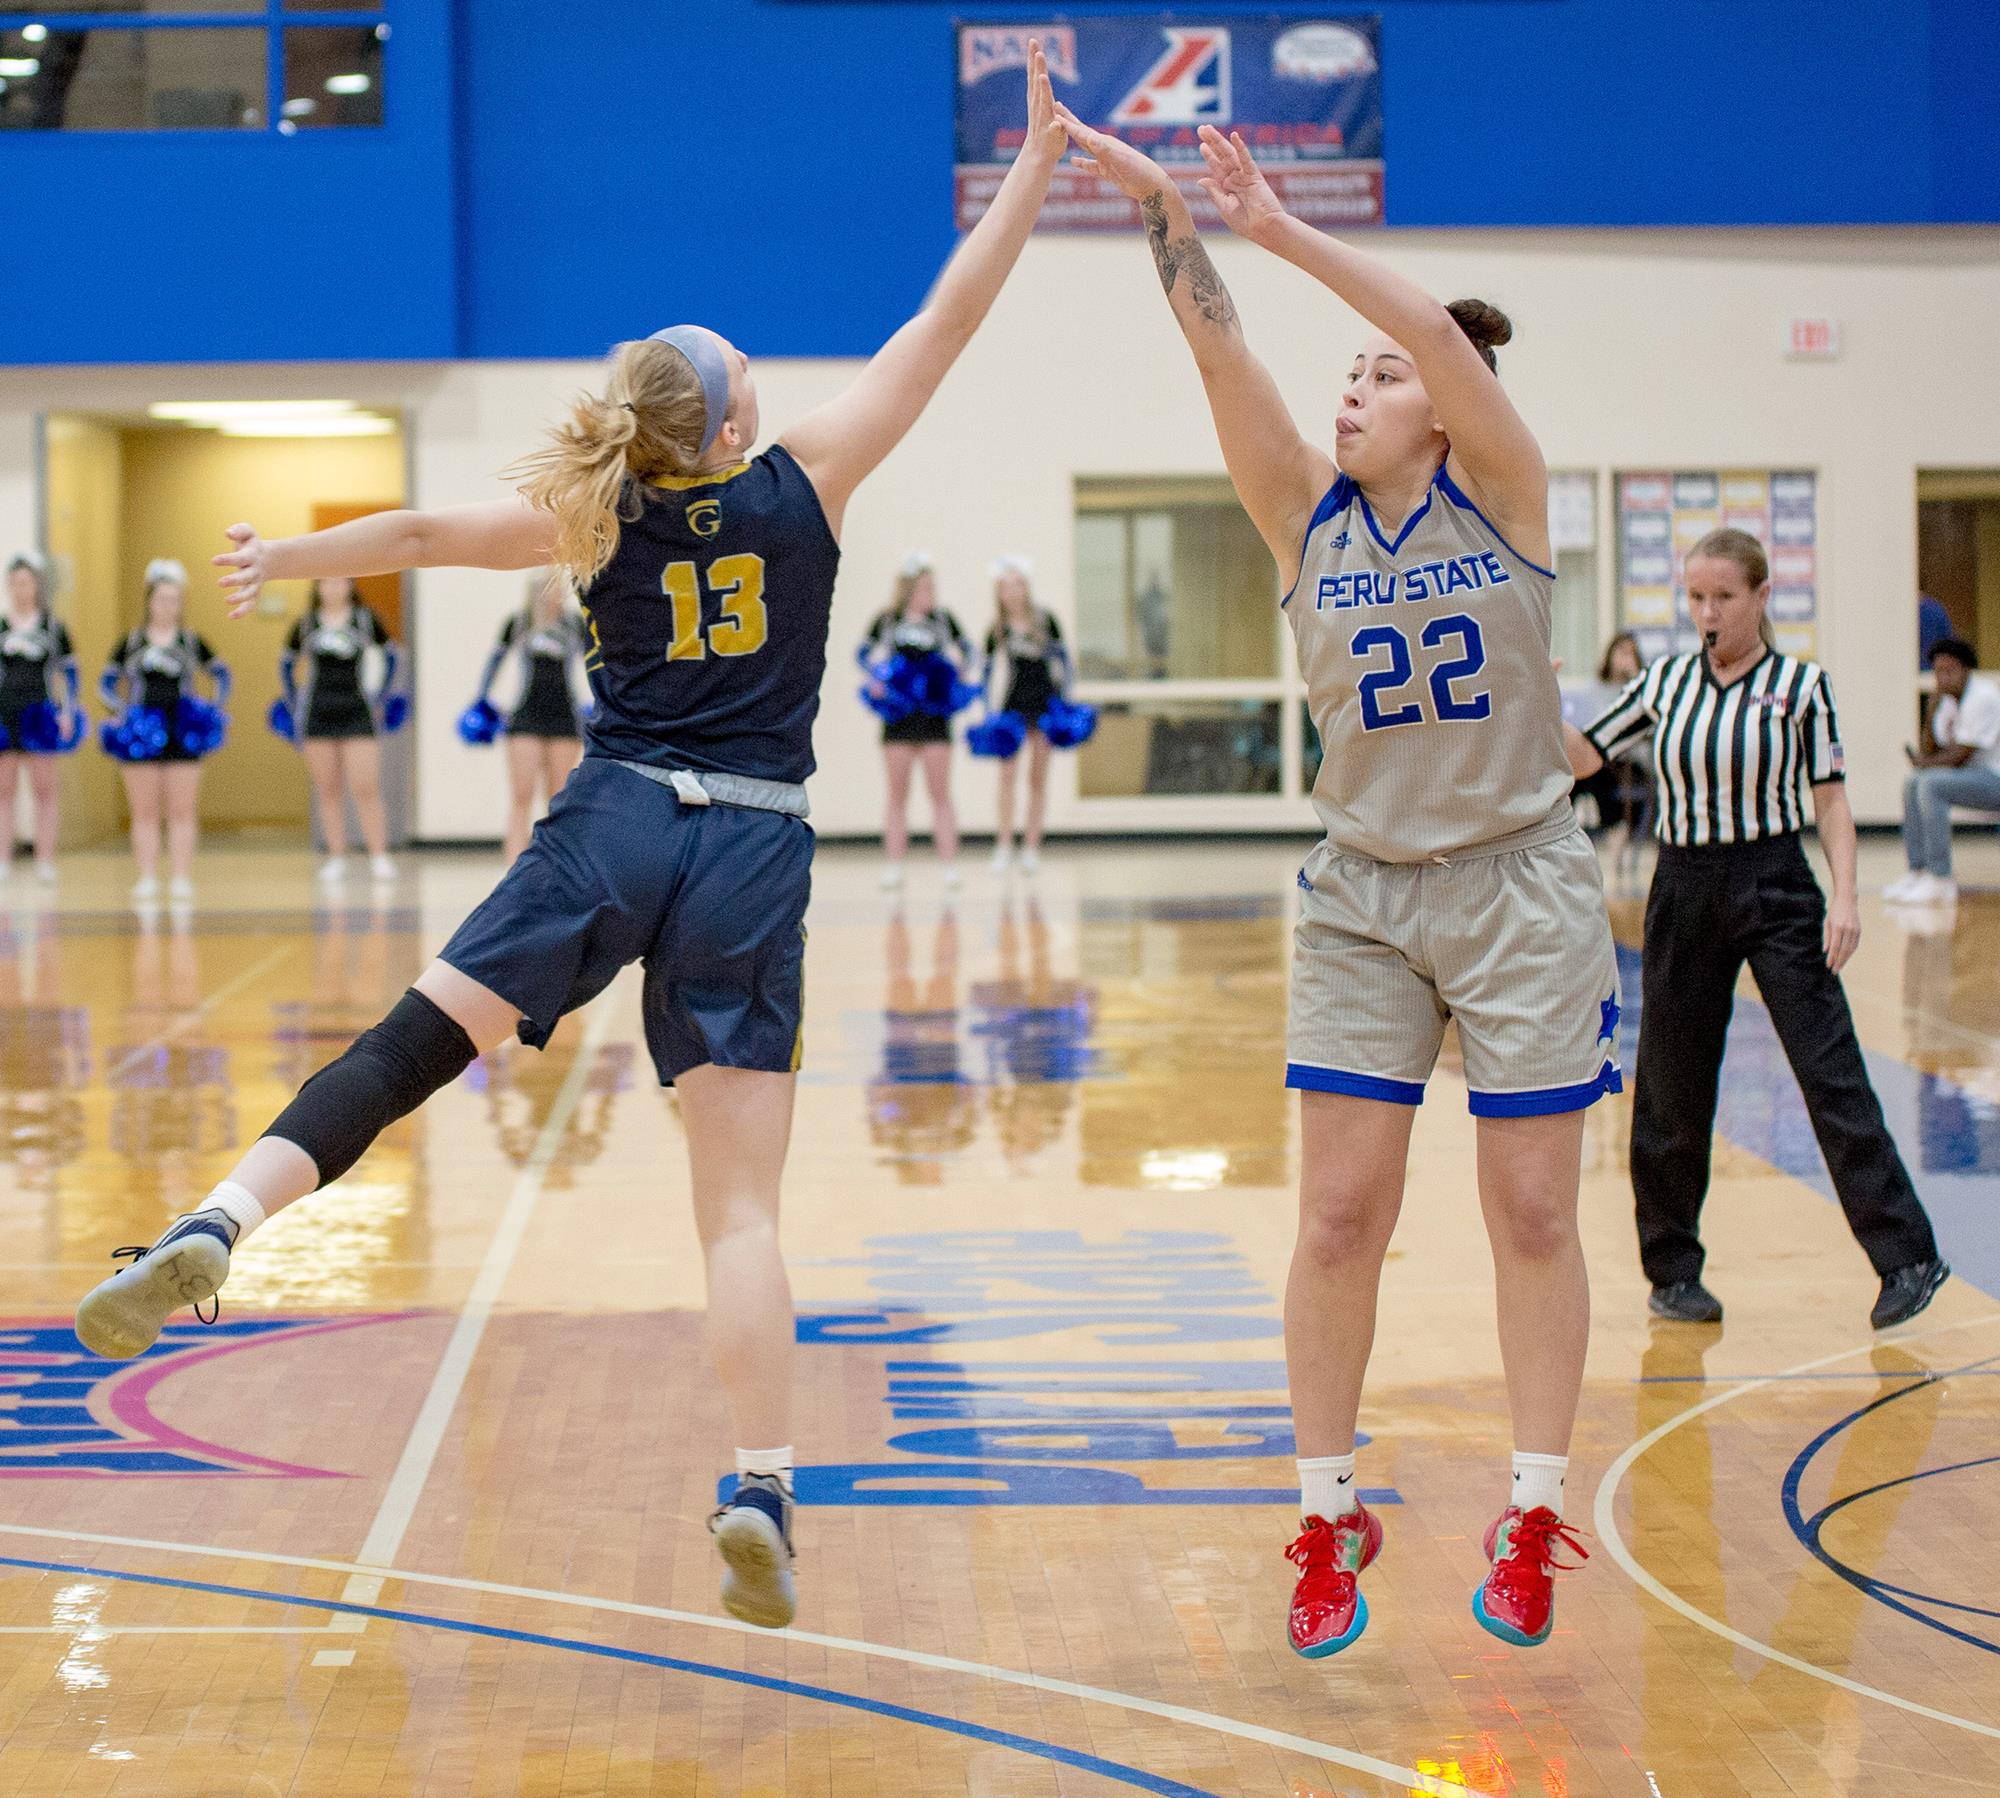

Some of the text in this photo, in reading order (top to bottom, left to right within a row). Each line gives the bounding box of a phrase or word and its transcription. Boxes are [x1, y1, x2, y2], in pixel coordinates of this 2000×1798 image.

[661, 553, 768, 662] 13
[1316, 549, 1511, 612] PERU STATE
[1349, 613, 1492, 733] 22
